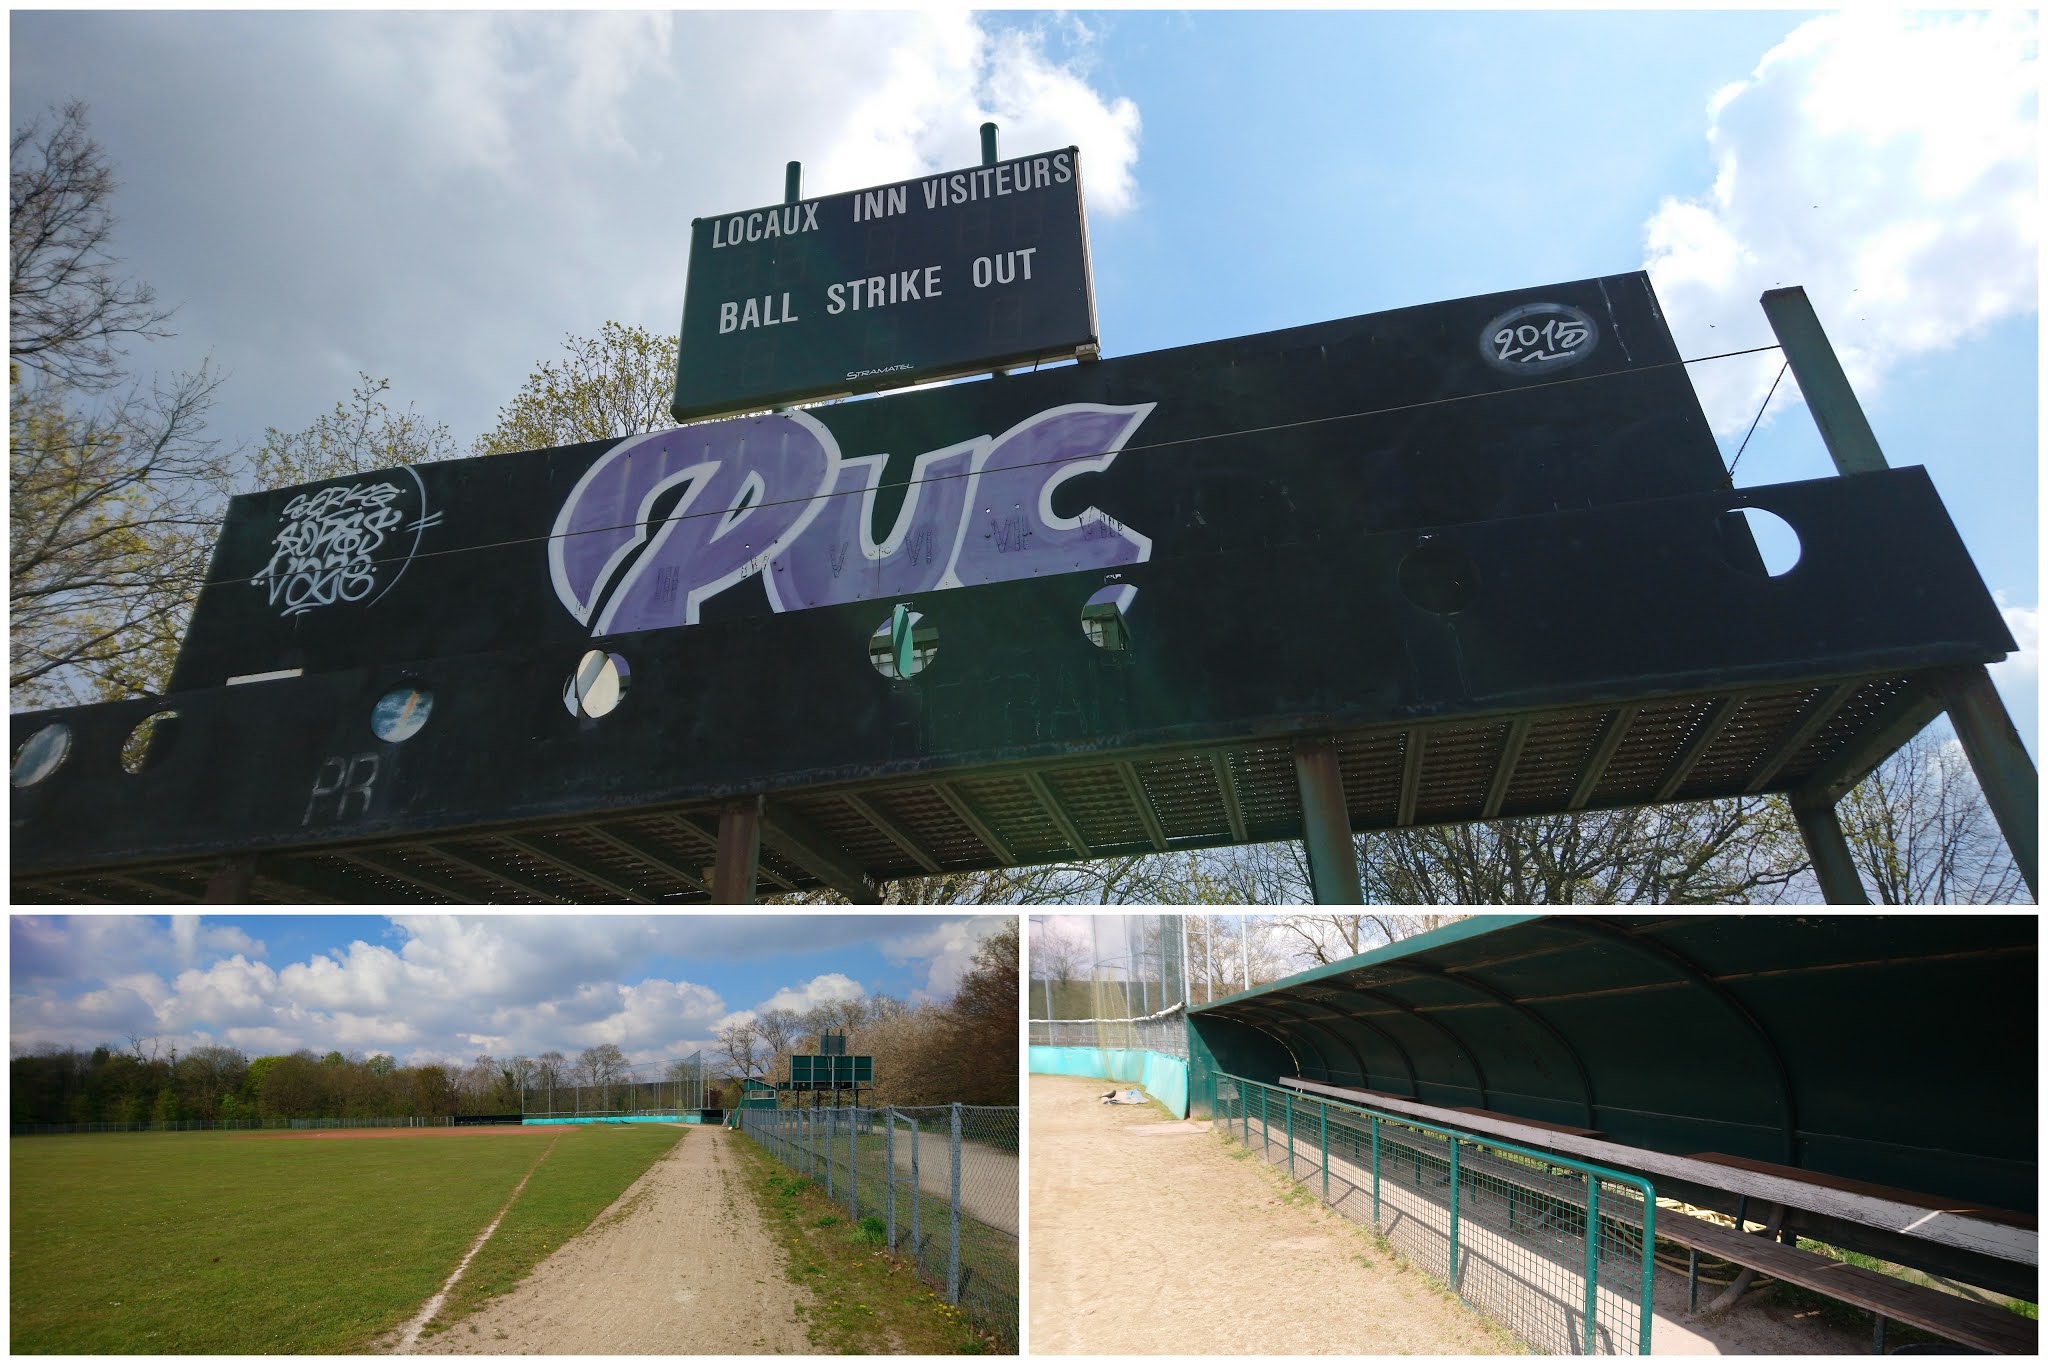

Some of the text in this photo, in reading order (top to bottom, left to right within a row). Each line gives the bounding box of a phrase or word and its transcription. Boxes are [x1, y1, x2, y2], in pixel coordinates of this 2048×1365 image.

[712, 153, 1072, 249] LOCAUX INN VISITEURS
[719, 247, 1037, 334] BALL STRIKE OUT
[845, 363, 914, 381] STRAMATEL
[1494, 319, 1588, 360] 2015
[547, 402, 1158, 637] PUC
[301, 752, 381, 827] PR
